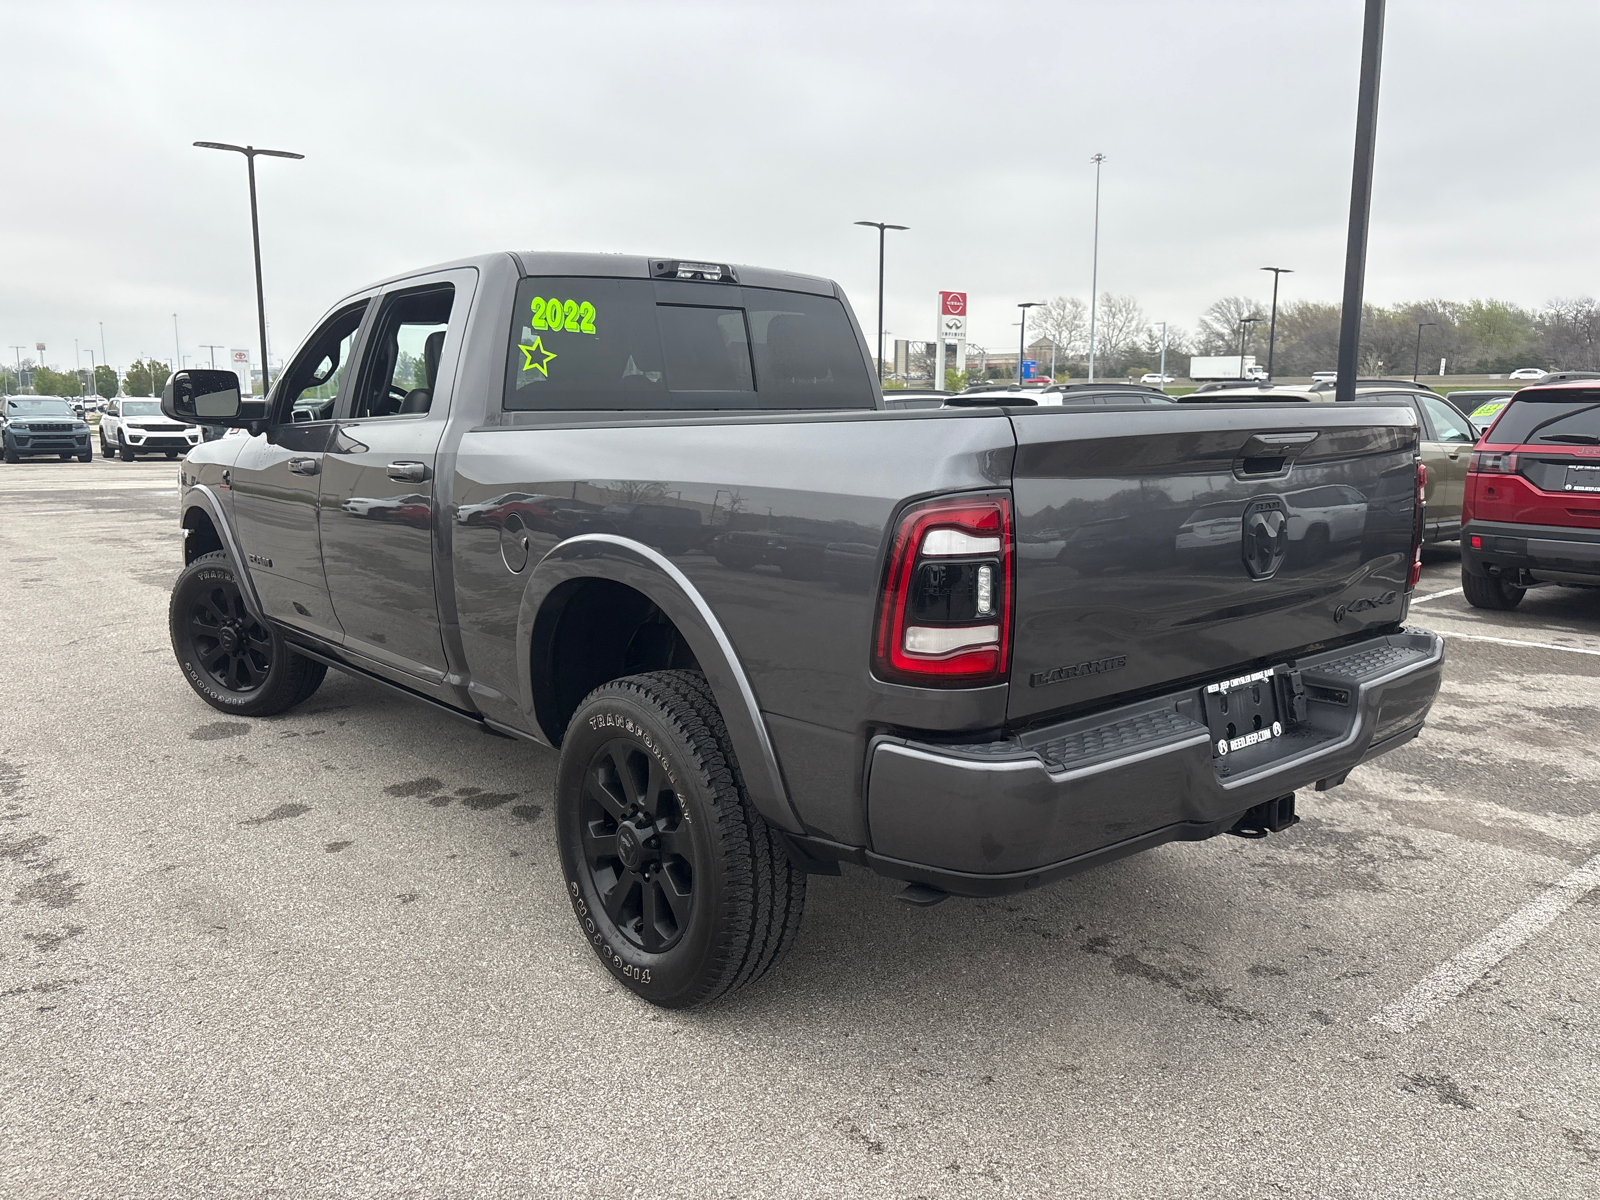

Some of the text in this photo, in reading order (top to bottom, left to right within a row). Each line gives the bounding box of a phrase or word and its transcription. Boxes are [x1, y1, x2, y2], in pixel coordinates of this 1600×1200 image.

[531, 296, 596, 334] 2022
[1255, 501, 1281, 511] RAM
[1029, 654, 1127, 688] LARAMIE
[1230, 728, 1272, 751] REEDJEEP.COM
